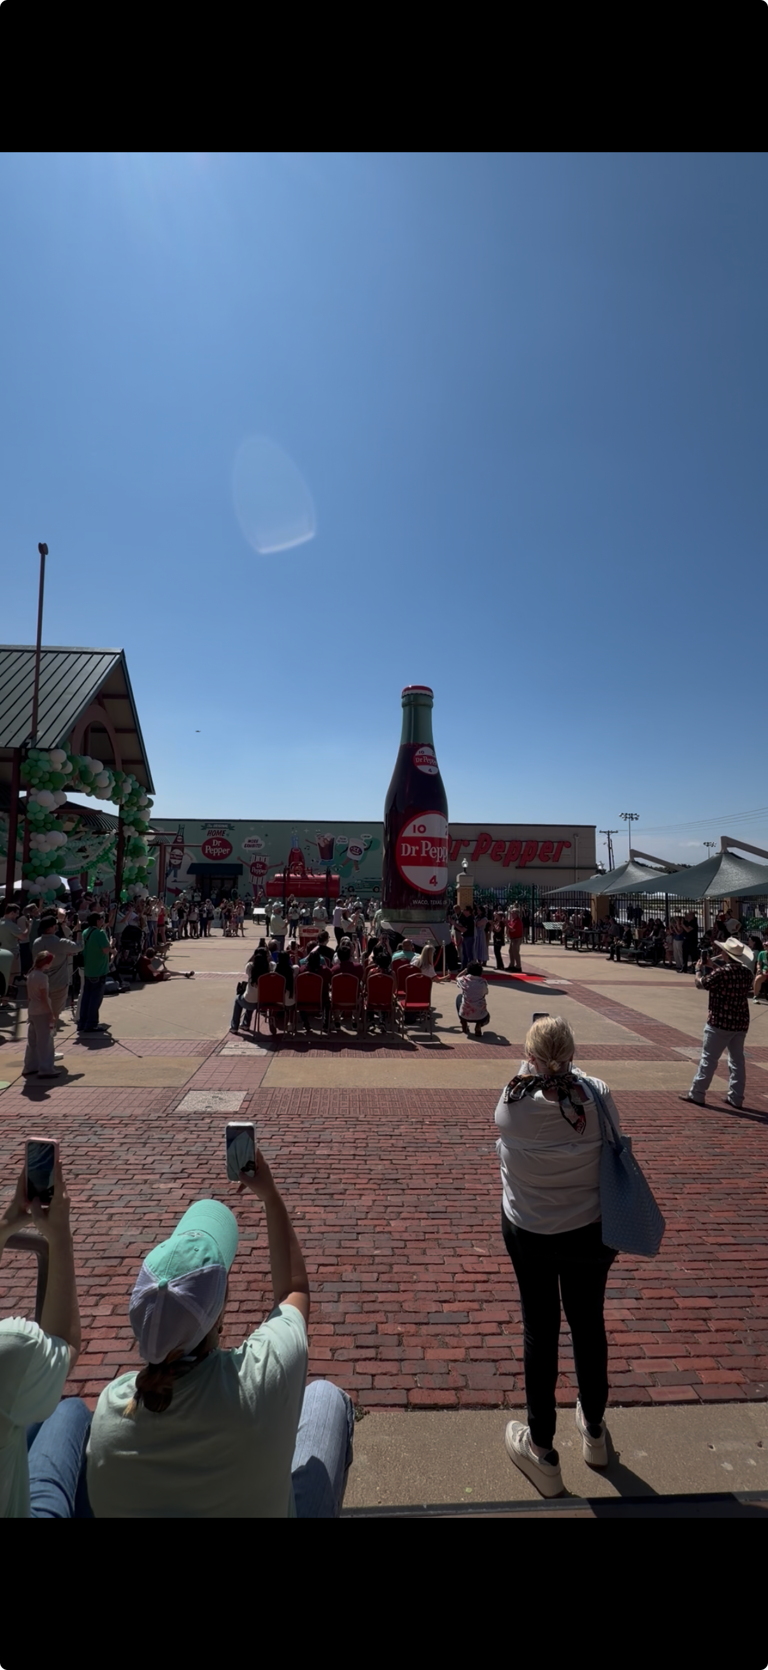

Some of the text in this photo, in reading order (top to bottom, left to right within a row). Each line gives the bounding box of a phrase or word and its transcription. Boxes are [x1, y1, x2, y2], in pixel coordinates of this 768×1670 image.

[412, 824, 427, 834] 10
[205, 845, 230, 856] Pepper
[401, 843, 419, 857] Dr
[471, 832, 572, 868] Pepper
[251, 866, 266, 874] Pepper
[429, 875, 438, 887] 4
